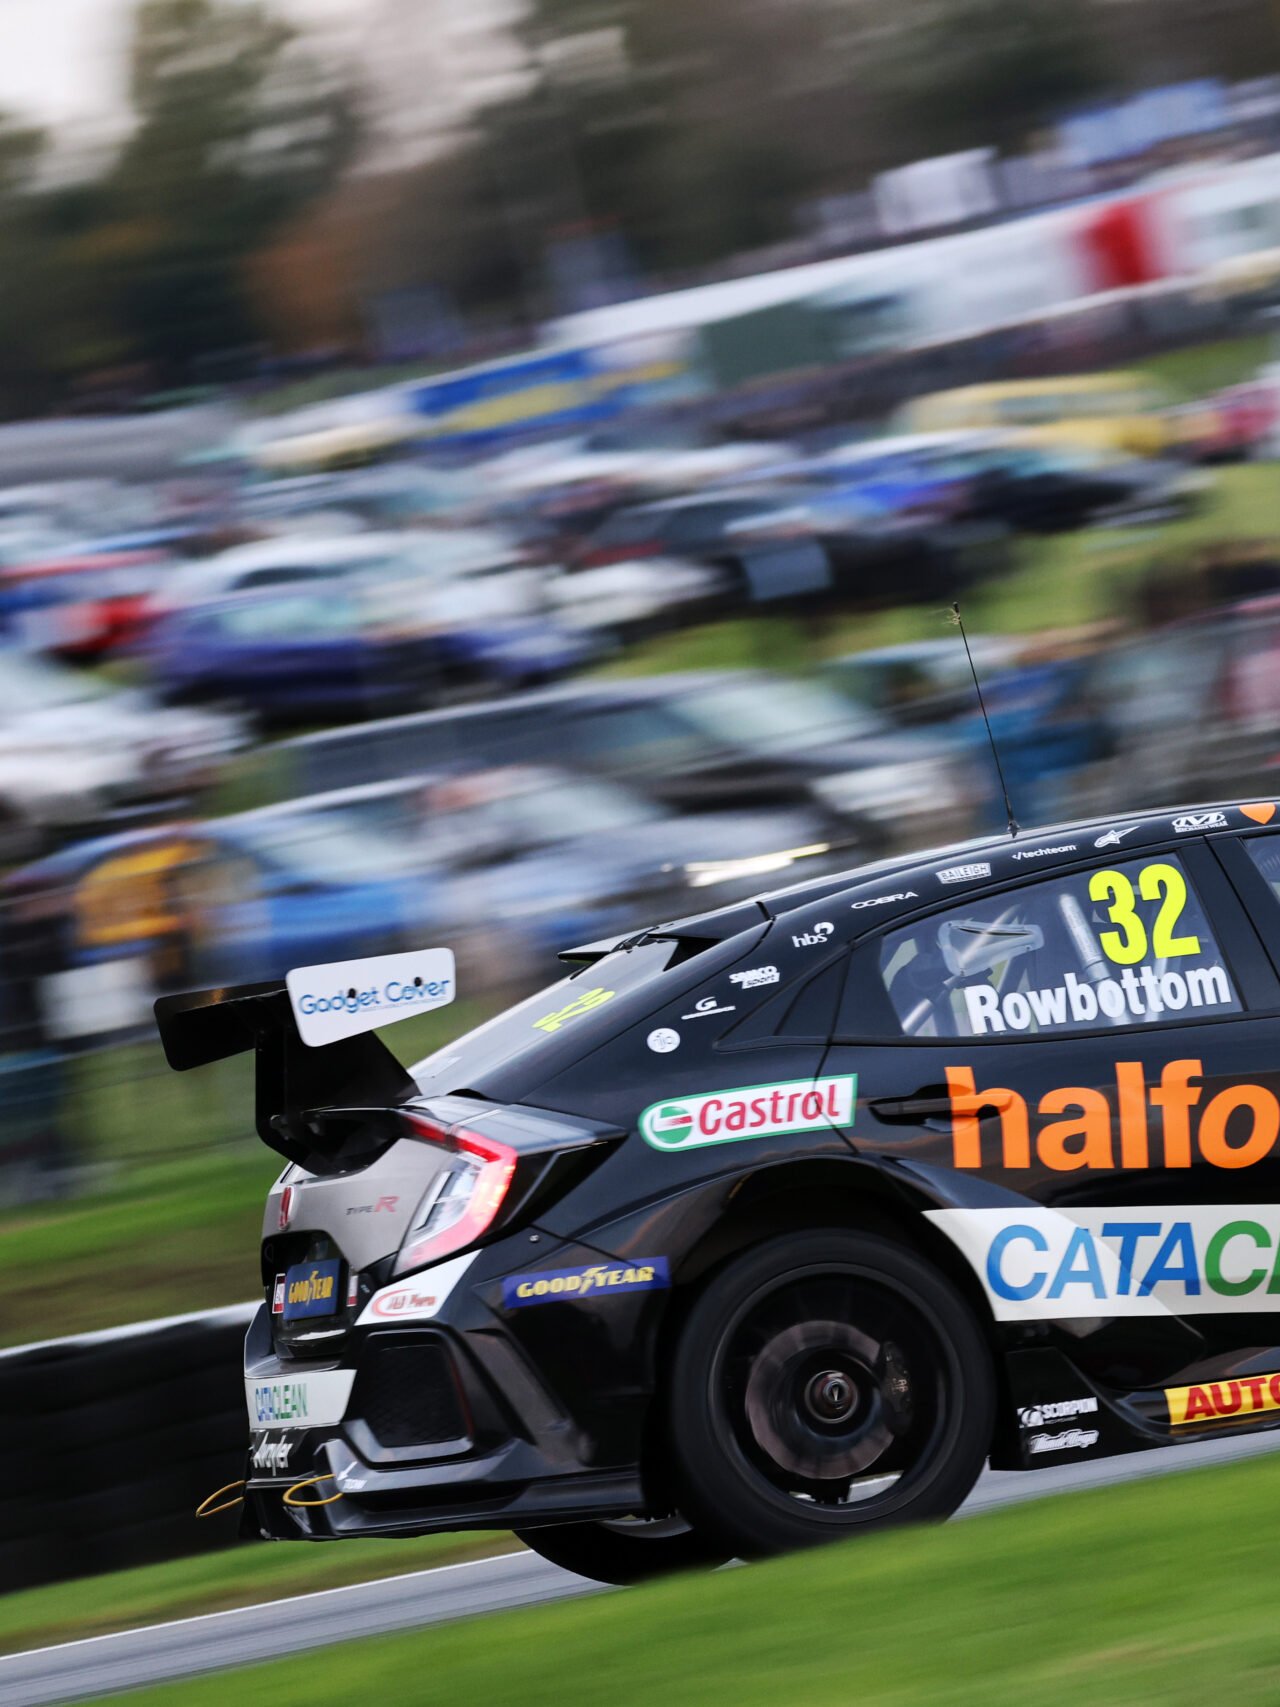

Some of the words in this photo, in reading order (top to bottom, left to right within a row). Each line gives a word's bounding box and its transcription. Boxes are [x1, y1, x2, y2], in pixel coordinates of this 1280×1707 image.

[940, 864, 988, 880] BAILEIGH
[851, 891, 919, 910] COBRA
[1088, 863, 1201, 965] 32
[792, 932, 828, 948] hbs
[300, 986, 380, 1014] Gadget
[385, 979, 451, 1002] Cover
[964, 964, 1232, 1035] Rowbottom
[699, 1084, 840, 1136] Castrol
[517, 1265, 655, 1298] GOODYEAR
